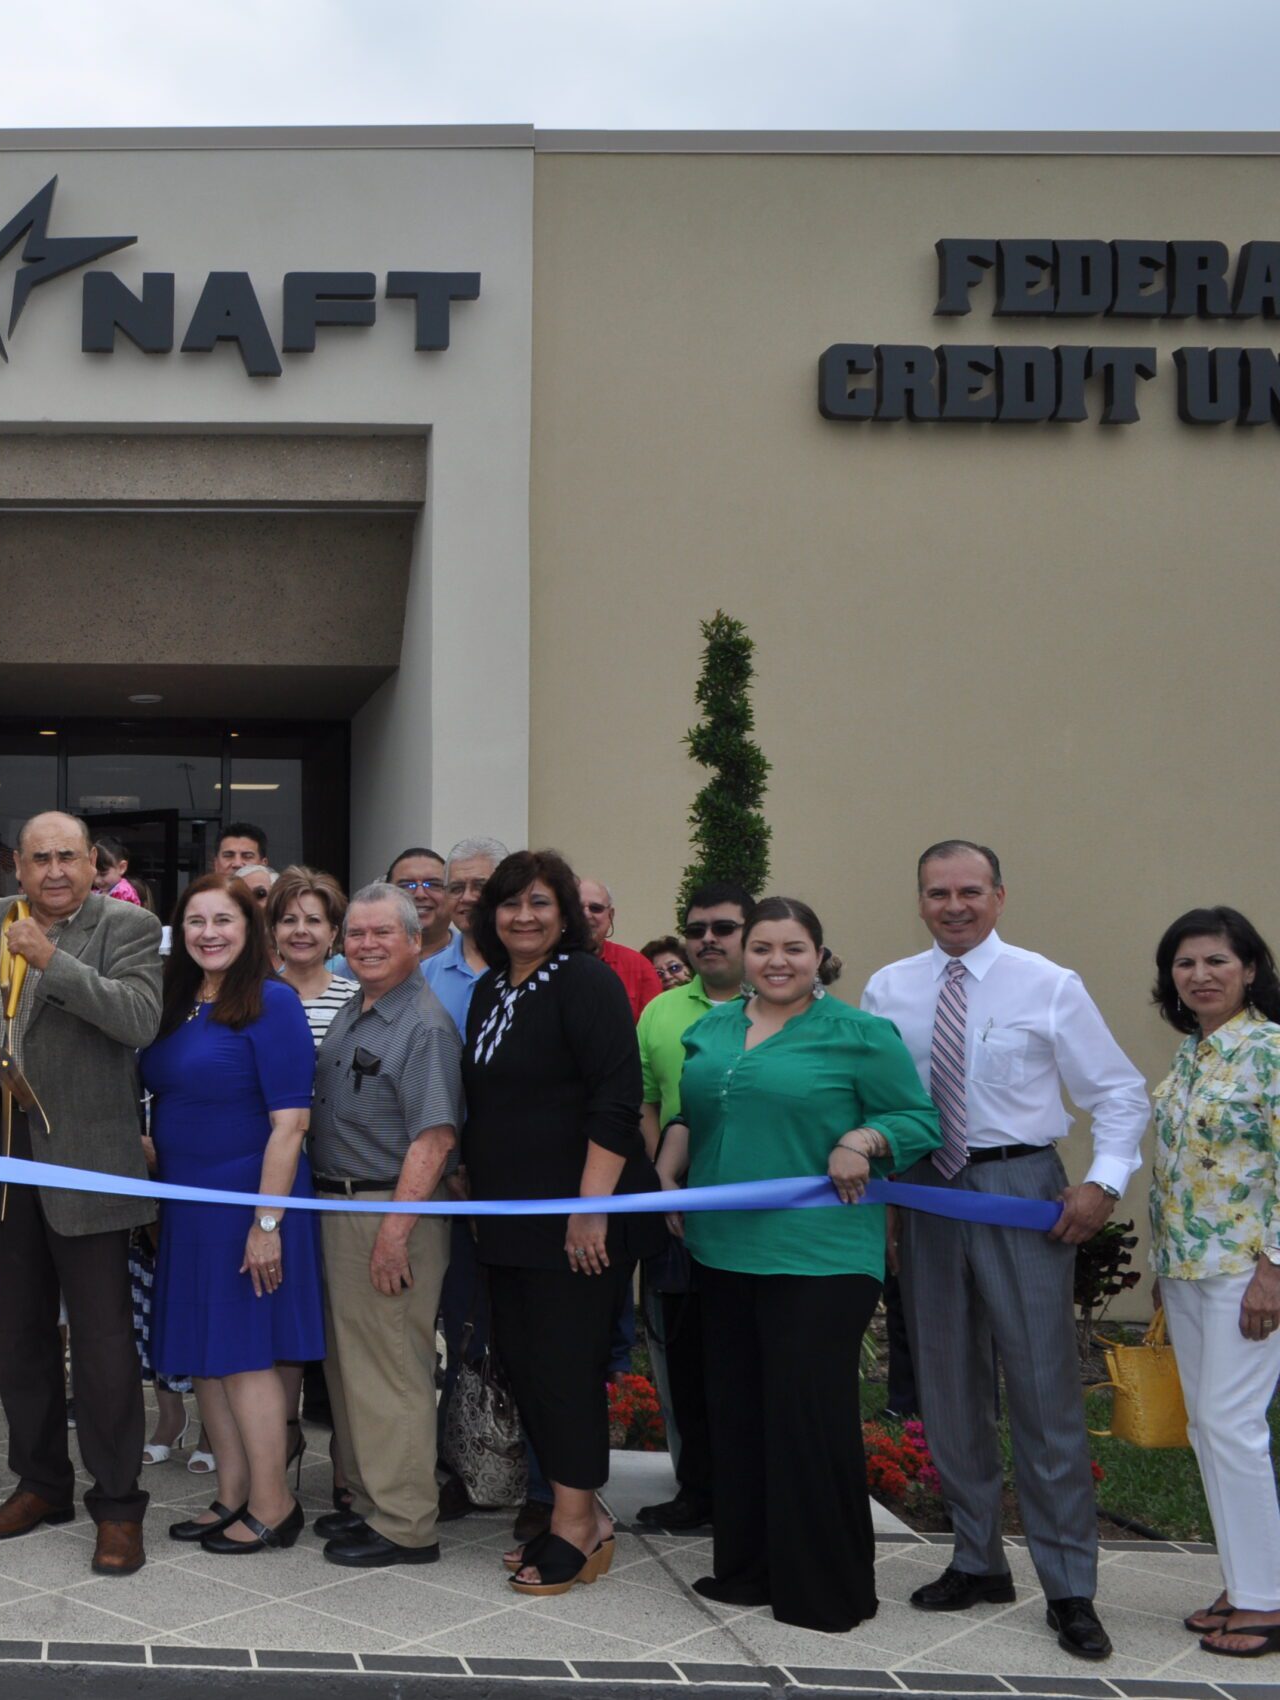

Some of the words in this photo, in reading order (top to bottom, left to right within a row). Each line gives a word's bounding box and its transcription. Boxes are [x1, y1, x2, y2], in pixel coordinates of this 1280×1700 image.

[933, 239, 1280, 318] FEDERA
[82, 271, 481, 377] NAFT
[818, 343, 1157, 424] CREDIT
